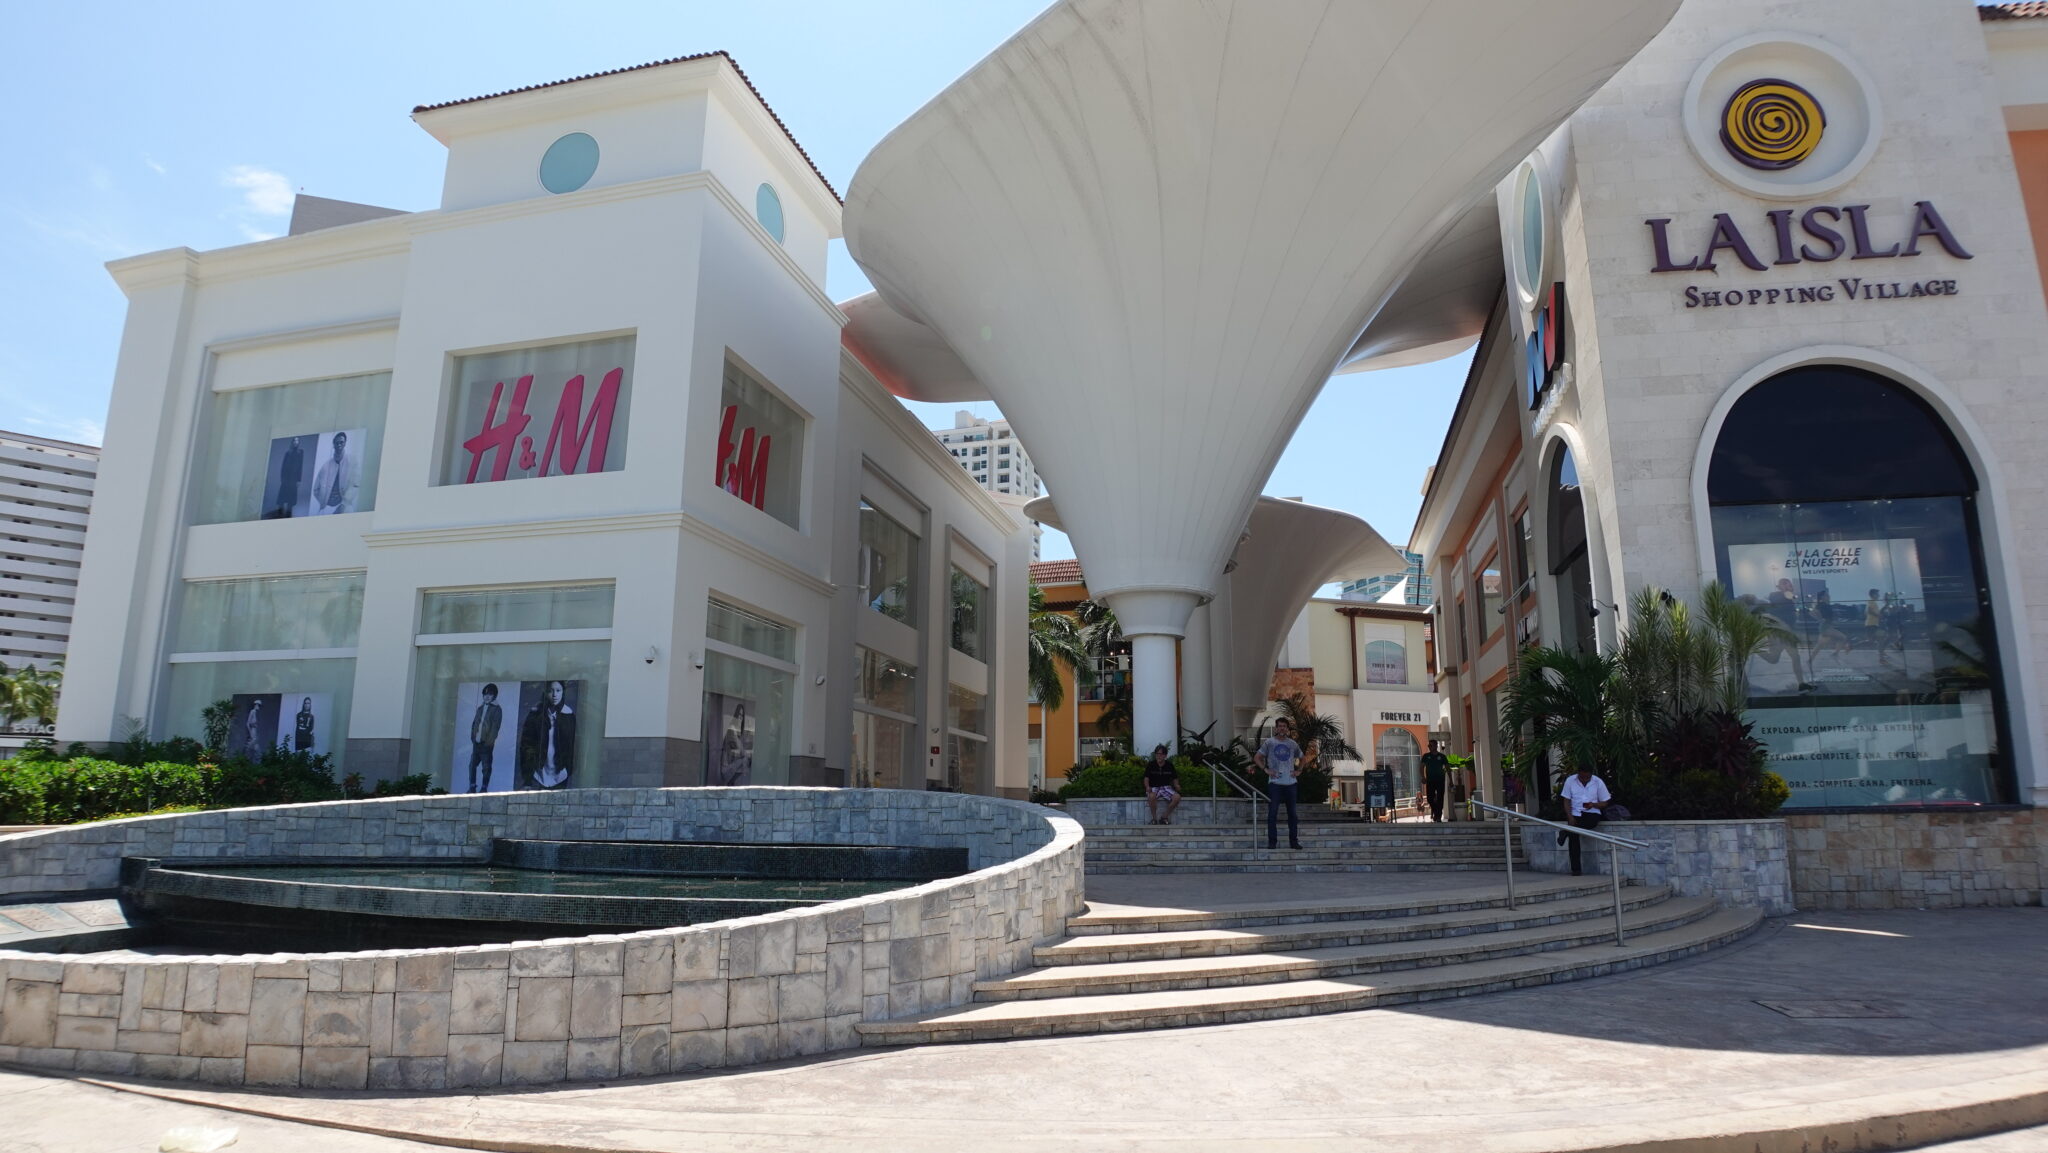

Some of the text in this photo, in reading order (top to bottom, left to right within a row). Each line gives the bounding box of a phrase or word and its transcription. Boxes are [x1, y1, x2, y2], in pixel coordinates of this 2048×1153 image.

[1644, 200, 1974, 273] LA ISLA
[463, 366, 624, 484] H&M
[1804, 549, 1820, 558] LA
[1823, 547, 1861, 557] CALLE
[1785, 557, 1860, 568] ES NUESTRA
[1381, 712, 1421, 721] FOREVER 21
